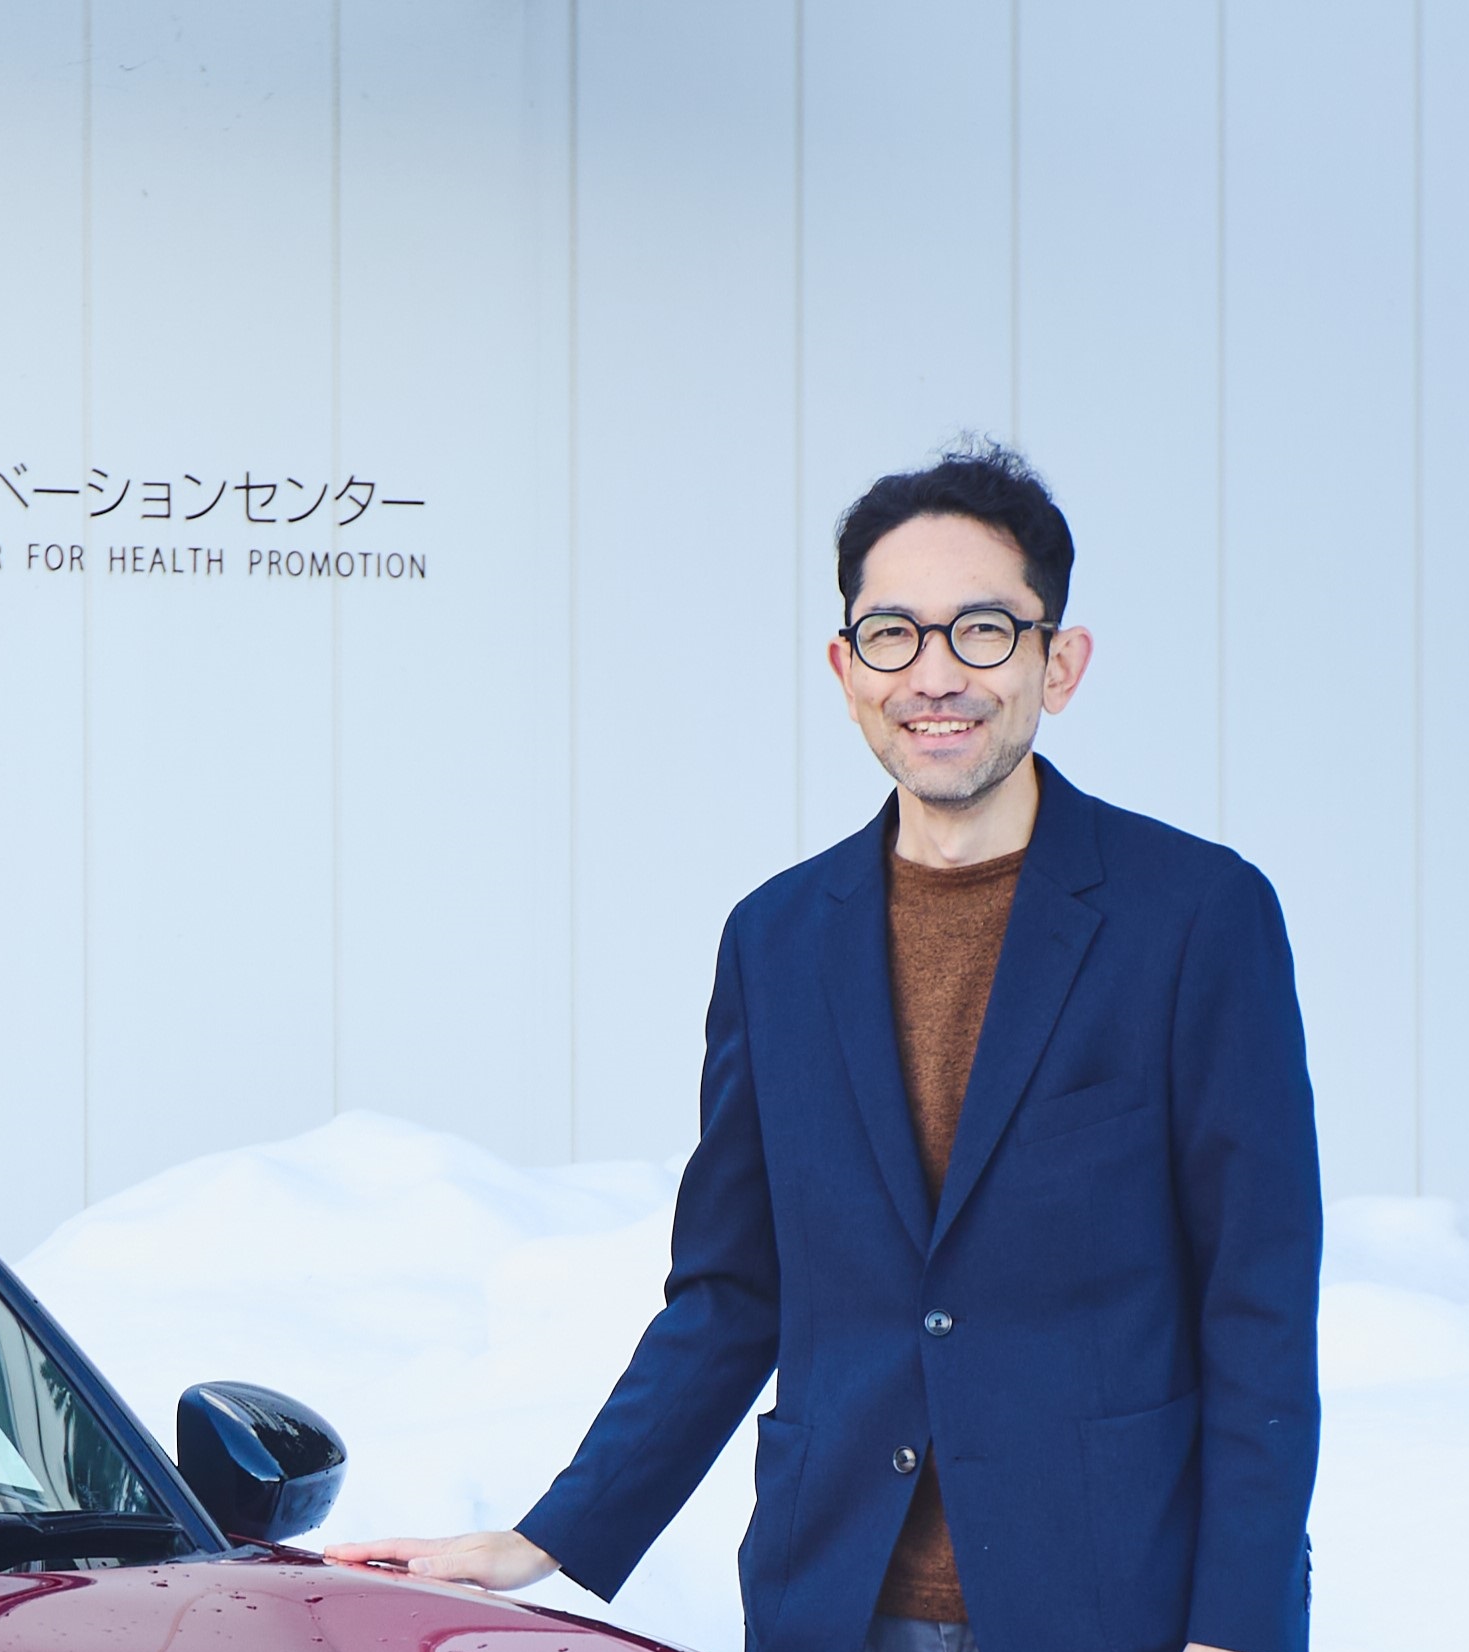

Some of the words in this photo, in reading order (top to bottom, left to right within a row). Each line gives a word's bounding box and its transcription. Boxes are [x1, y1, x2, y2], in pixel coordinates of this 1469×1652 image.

[27, 543, 85, 573] FOR
[108, 545, 224, 577] HEALTH
[248, 548, 427, 580] PROMOTION
